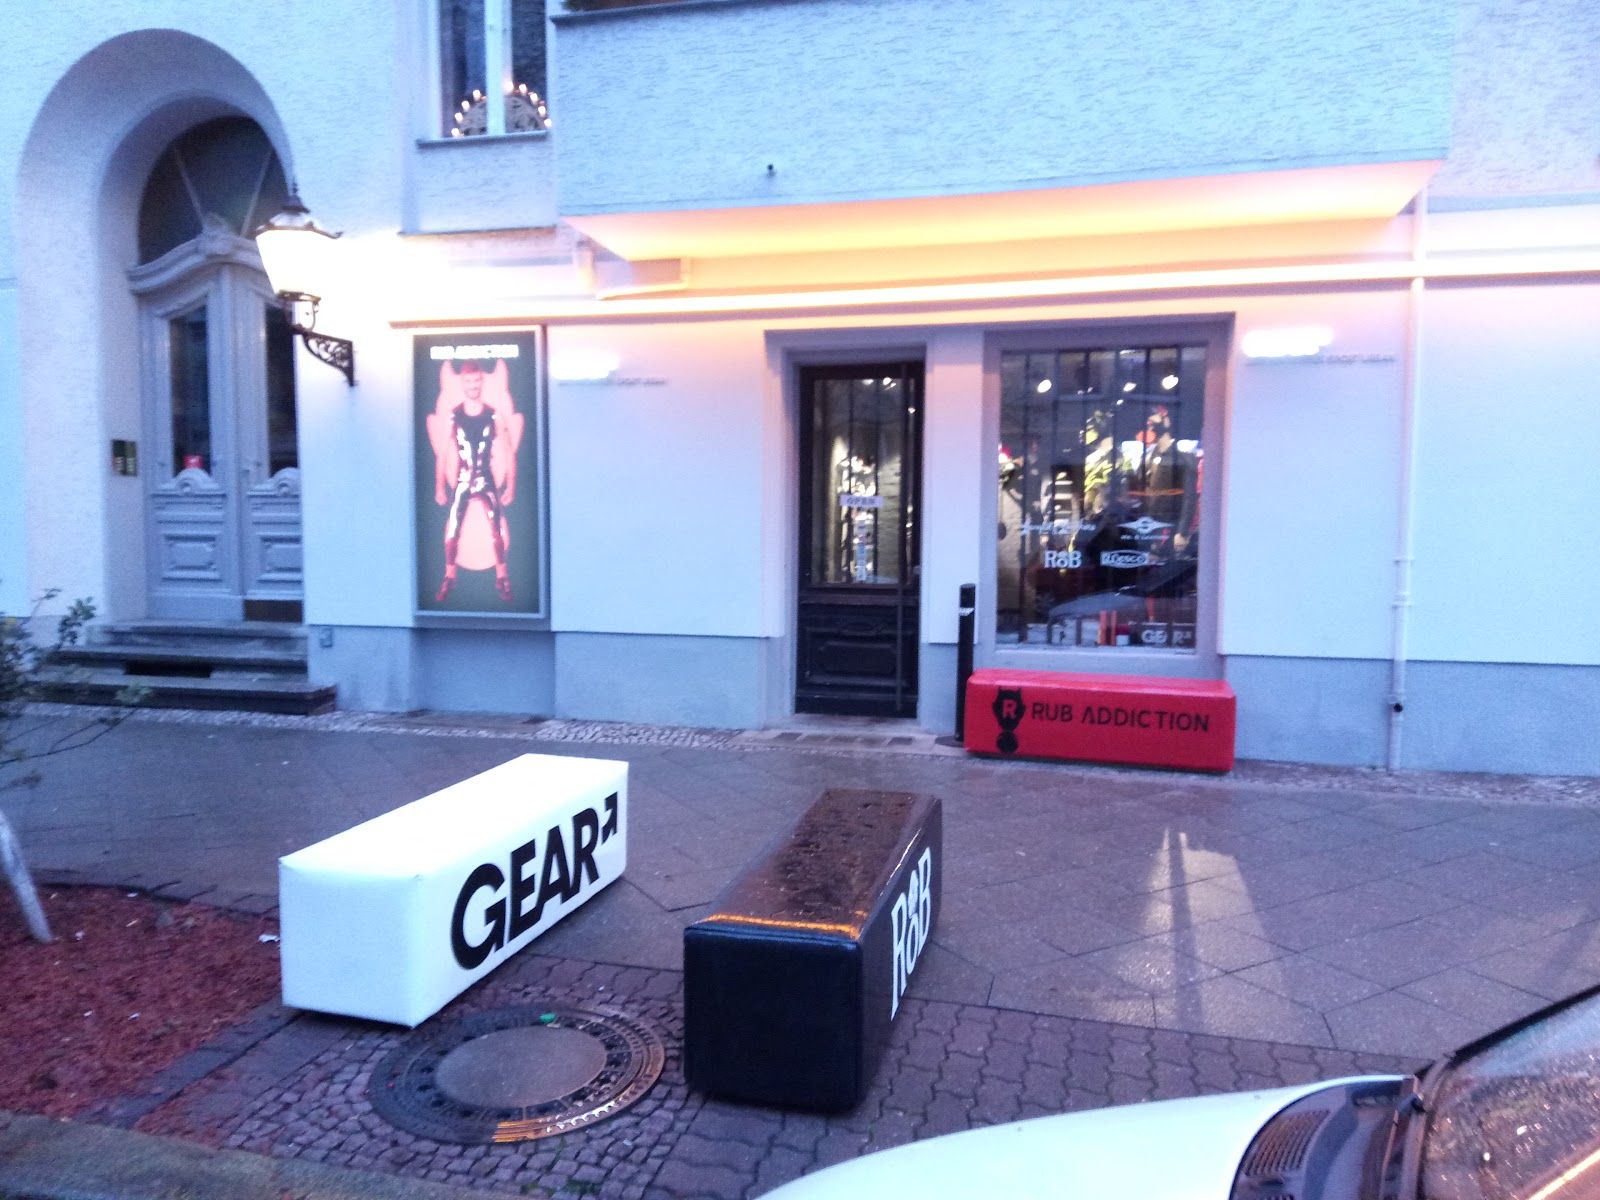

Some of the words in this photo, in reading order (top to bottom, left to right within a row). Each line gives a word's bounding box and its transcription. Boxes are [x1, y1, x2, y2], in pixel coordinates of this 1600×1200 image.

[1032, 702, 1073, 723] RUB
[1081, 706, 1211, 732] ADDICTION
[450, 807, 600, 971] GEAR
